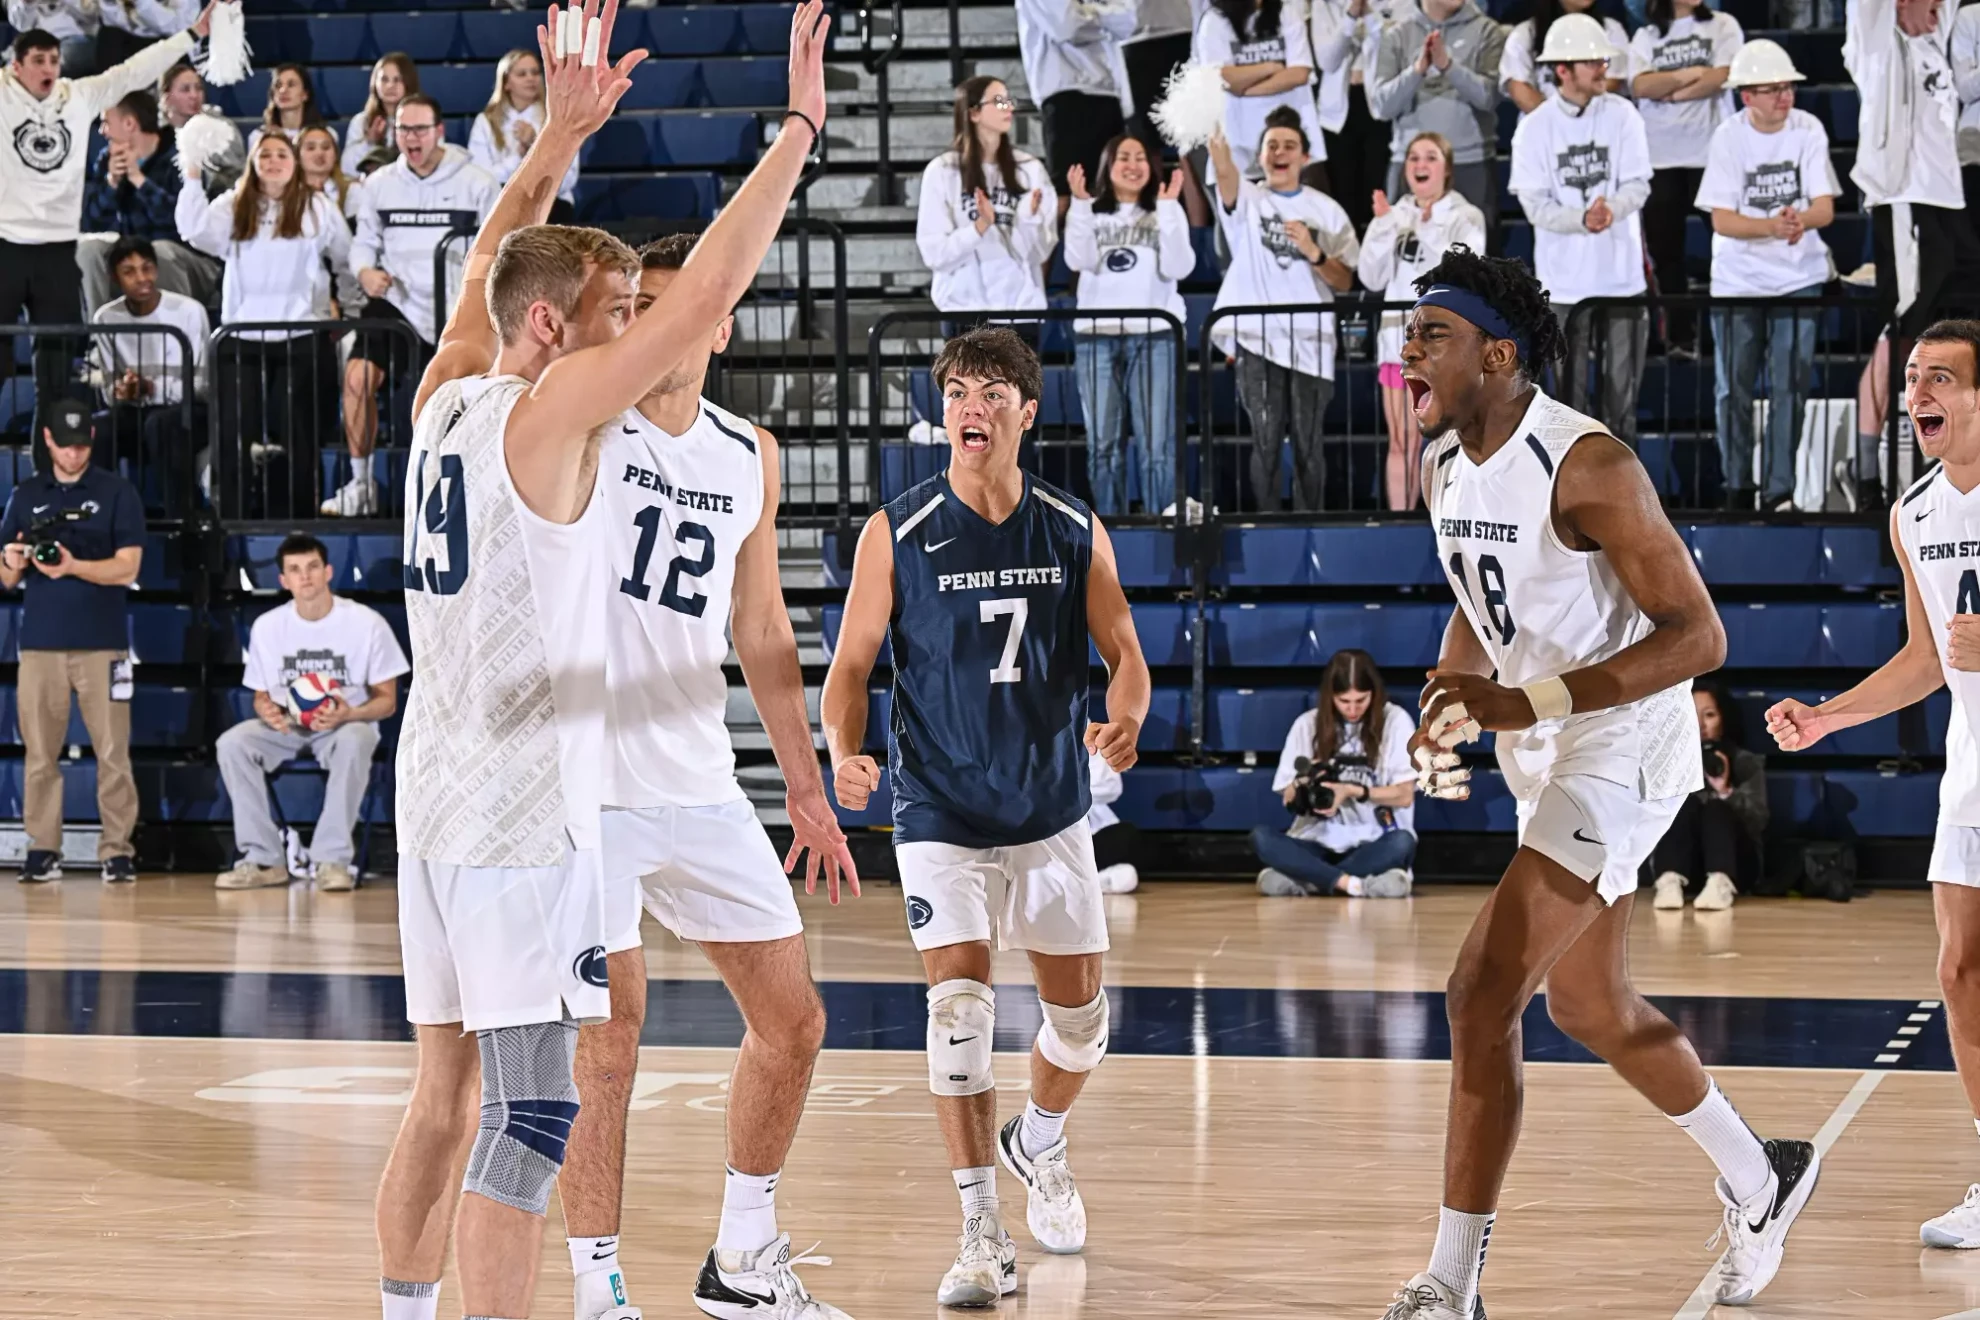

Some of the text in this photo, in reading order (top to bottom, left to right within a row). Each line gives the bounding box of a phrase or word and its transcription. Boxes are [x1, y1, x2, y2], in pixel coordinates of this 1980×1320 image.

[676, 487, 734, 514] STATE
[1439, 518, 1518, 543] PENN STATE
[619, 505, 715, 618] 12
[1919, 542, 1956, 561] PENN
[938, 567, 1062, 592] PENN STATE
[1449, 552, 1517, 646] 18
[979, 598, 1028, 684] 7
[295, 658, 334, 672] MEN'S
[487, 689, 520, 724] PENN
[518, 657, 548, 693] STAT
[510, 767, 538, 797] ARE
